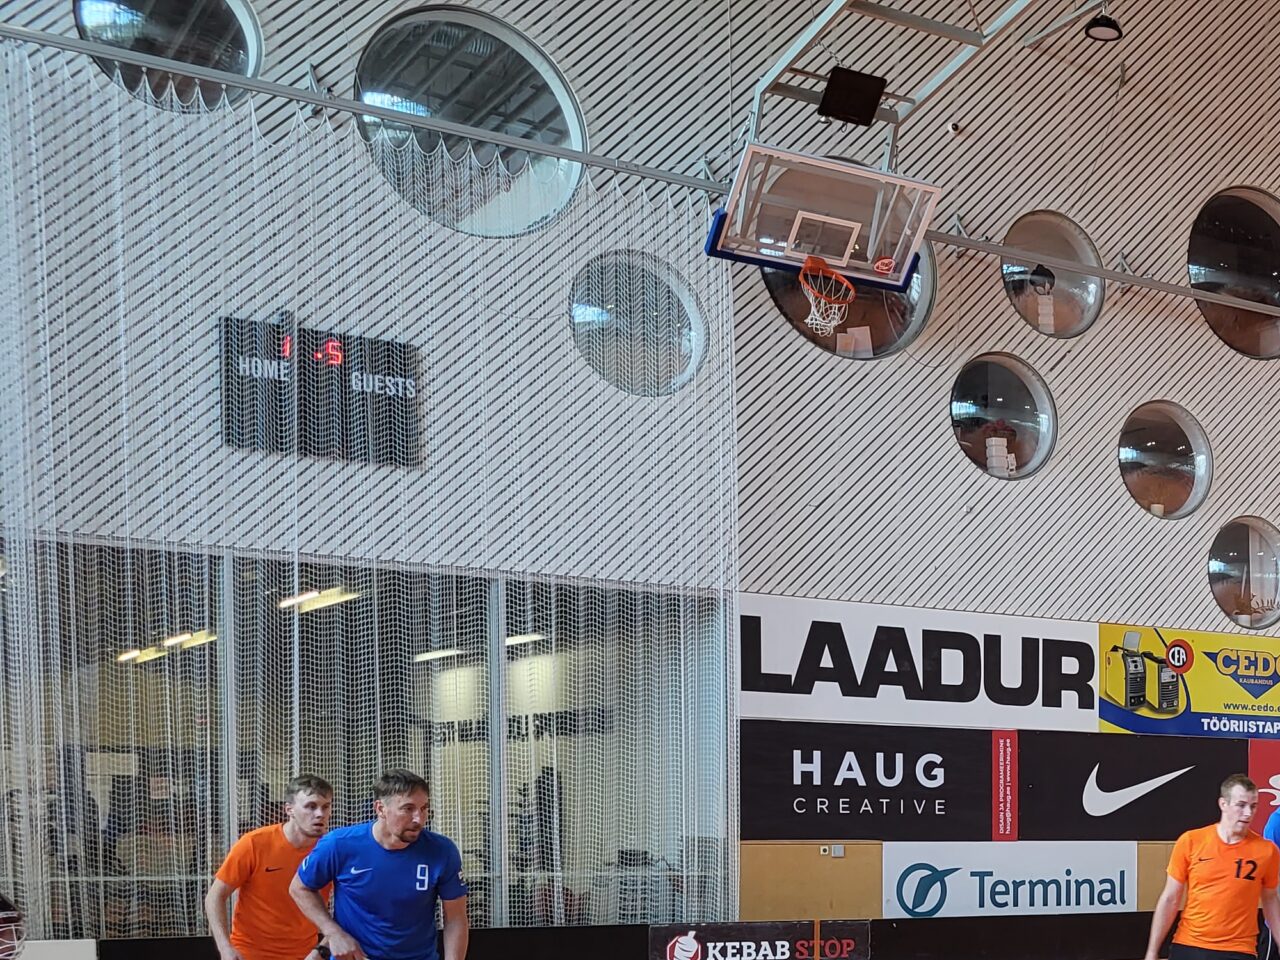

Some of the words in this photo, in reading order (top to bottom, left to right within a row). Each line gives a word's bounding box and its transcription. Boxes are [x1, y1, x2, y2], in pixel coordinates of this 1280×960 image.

[238, 356, 291, 381] HOME
[351, 372, 416, 398] GUESTS
[740, 614, 1096, 710] LAADUR
[1239, 678, 1274, 687] KAUBANDUS
[793, 750, 946, 789] HAUG
[793, 798, 946, 815] CREATIVE
[415, 864, 429, 891] 9
[1234, 858, 1259, 881] 12
[969, 868, 1126, 909] Terminal
